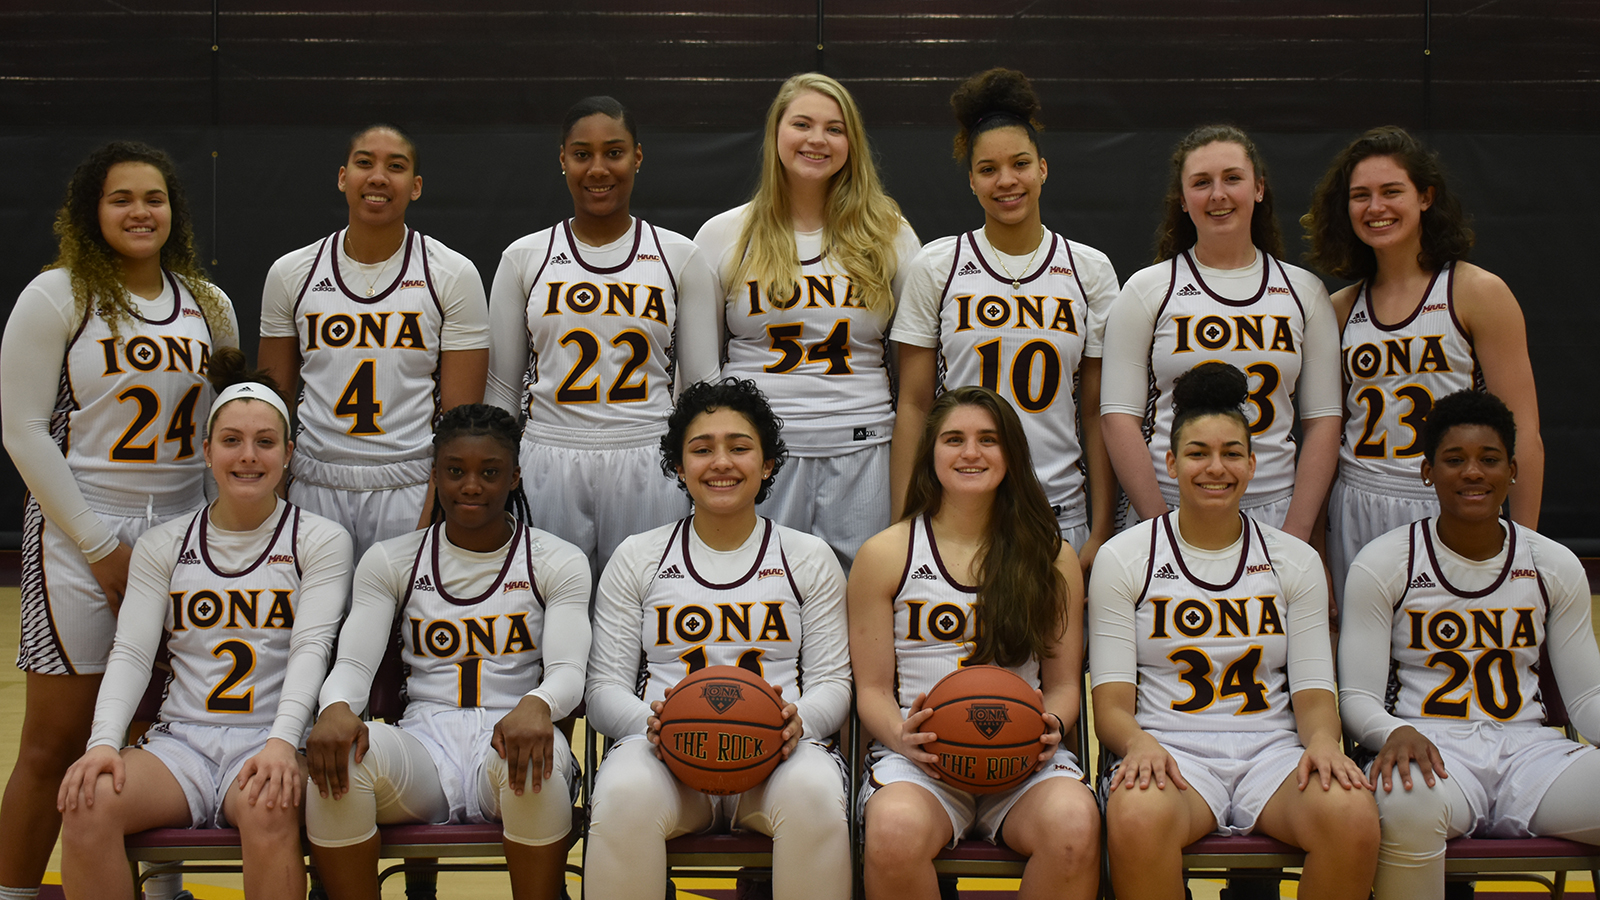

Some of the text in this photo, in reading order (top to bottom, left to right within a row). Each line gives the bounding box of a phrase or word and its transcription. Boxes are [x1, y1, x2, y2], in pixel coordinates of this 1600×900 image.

[312, 285, 336, 293] adidas
[400, 279, 426, 289] MAAC
[958, 268, 981, 277] adidas
[1050, 266, 1073, 276] MAAC
[542, 281, 669, 327] IONA
[954, 294, 1079, 336] IONA
[1421, 303, 1448, 315] MAAC
[304, 311, 429, 351] IONA
[763, 318, 854, 375] 54
[1171, 314, 1297, 355] IONA
[555, 327, 651, 404] 22
[973, 336, 1062, 414] 10
[1342, 334, 1453, 384] IONA
[333, 358, 386, 436] 4
[1191, 359, 1281, 436] 3
[109, 383, 204, 463] 24
[1354, 383, 1435, 459] 23
[267, 554, 294, 565] MAAC
[757, 568, 785, 580] MAAC
[911, 572, 937, 580] adidas
[1154, 572, 1179, 580] adidas
[1246, 563, 1272, 575] MAAC
[1510, 569, 1537, 581] MAAC
[503, 581, 530, 594] MAAC
[169, 589, 295, 632] IONA
[654, 601, 792, 647] IONA
[904, 600, 985, 642] IO
[1148, 594, 1286, 639] IONA
[1404, 607, 1537, 651] IONA
[409, 611, 537, 659] IONA
[205, 638, 257, 714] 2
[454, 658, 483, 708] 1
[701, 686, 743, 699] IONA
[1166, 645, 1271, 716] 34
[1421, 649, 1523, 722] 20
[968, 709, 1010, 722] IONA
[673, 731, 765, 762] THE ROCK
[940, 752, 1029, 780] THE ROCK
